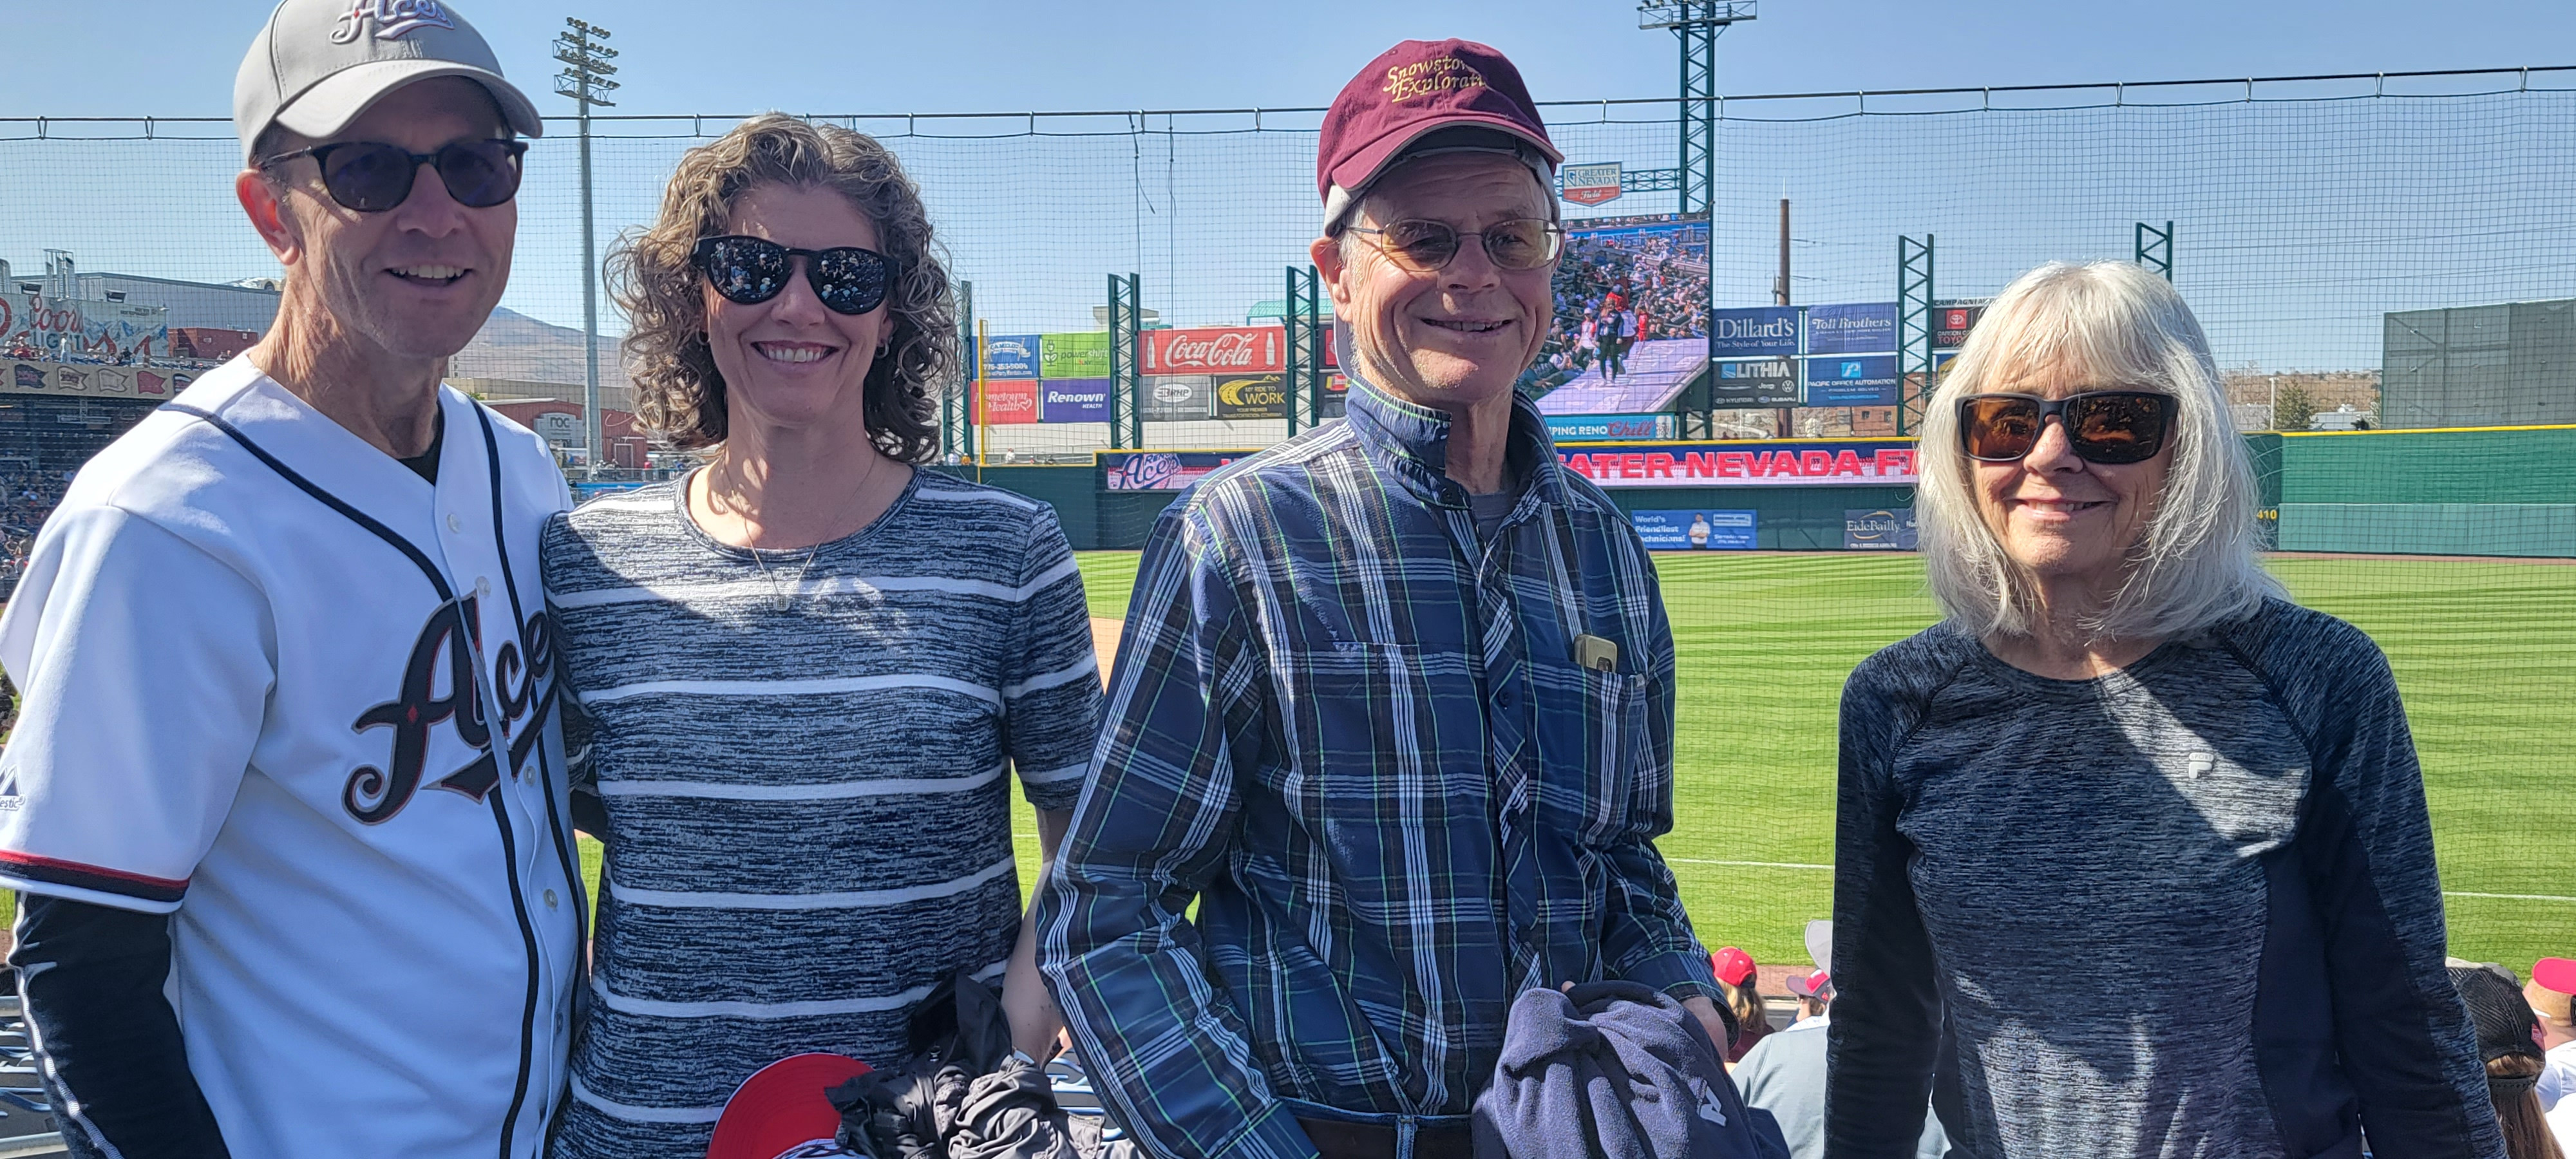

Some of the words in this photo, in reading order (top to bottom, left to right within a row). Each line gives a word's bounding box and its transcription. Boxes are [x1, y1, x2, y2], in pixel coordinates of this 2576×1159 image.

[1383, 55, 1466, 92] Snowstor
[1578, 169, 1616, 178] GREATER
[1577, 177, 1616, 186] NEVADA
[1717, 317, 1795, 339] Dillard's
[1812, 318, 1835, 330] Toll
[1839, 316, 1891, 329] Brothers
[1165, 333, 1258, 367] Coca-Cola
[1731, 340, 1750, 350] Style
[1736, 362, 1790, 379] LITHIA
[1048, 390, 1104, 403] Renown
[1245, 392, 1285, 405] WORK
[989, 400, 1020, 411] Health
[1578, 426, 1608, 436] RENO
[1685, 449, 1864, 478] NEVADA
[2256, 509, 2278, 520] 410
